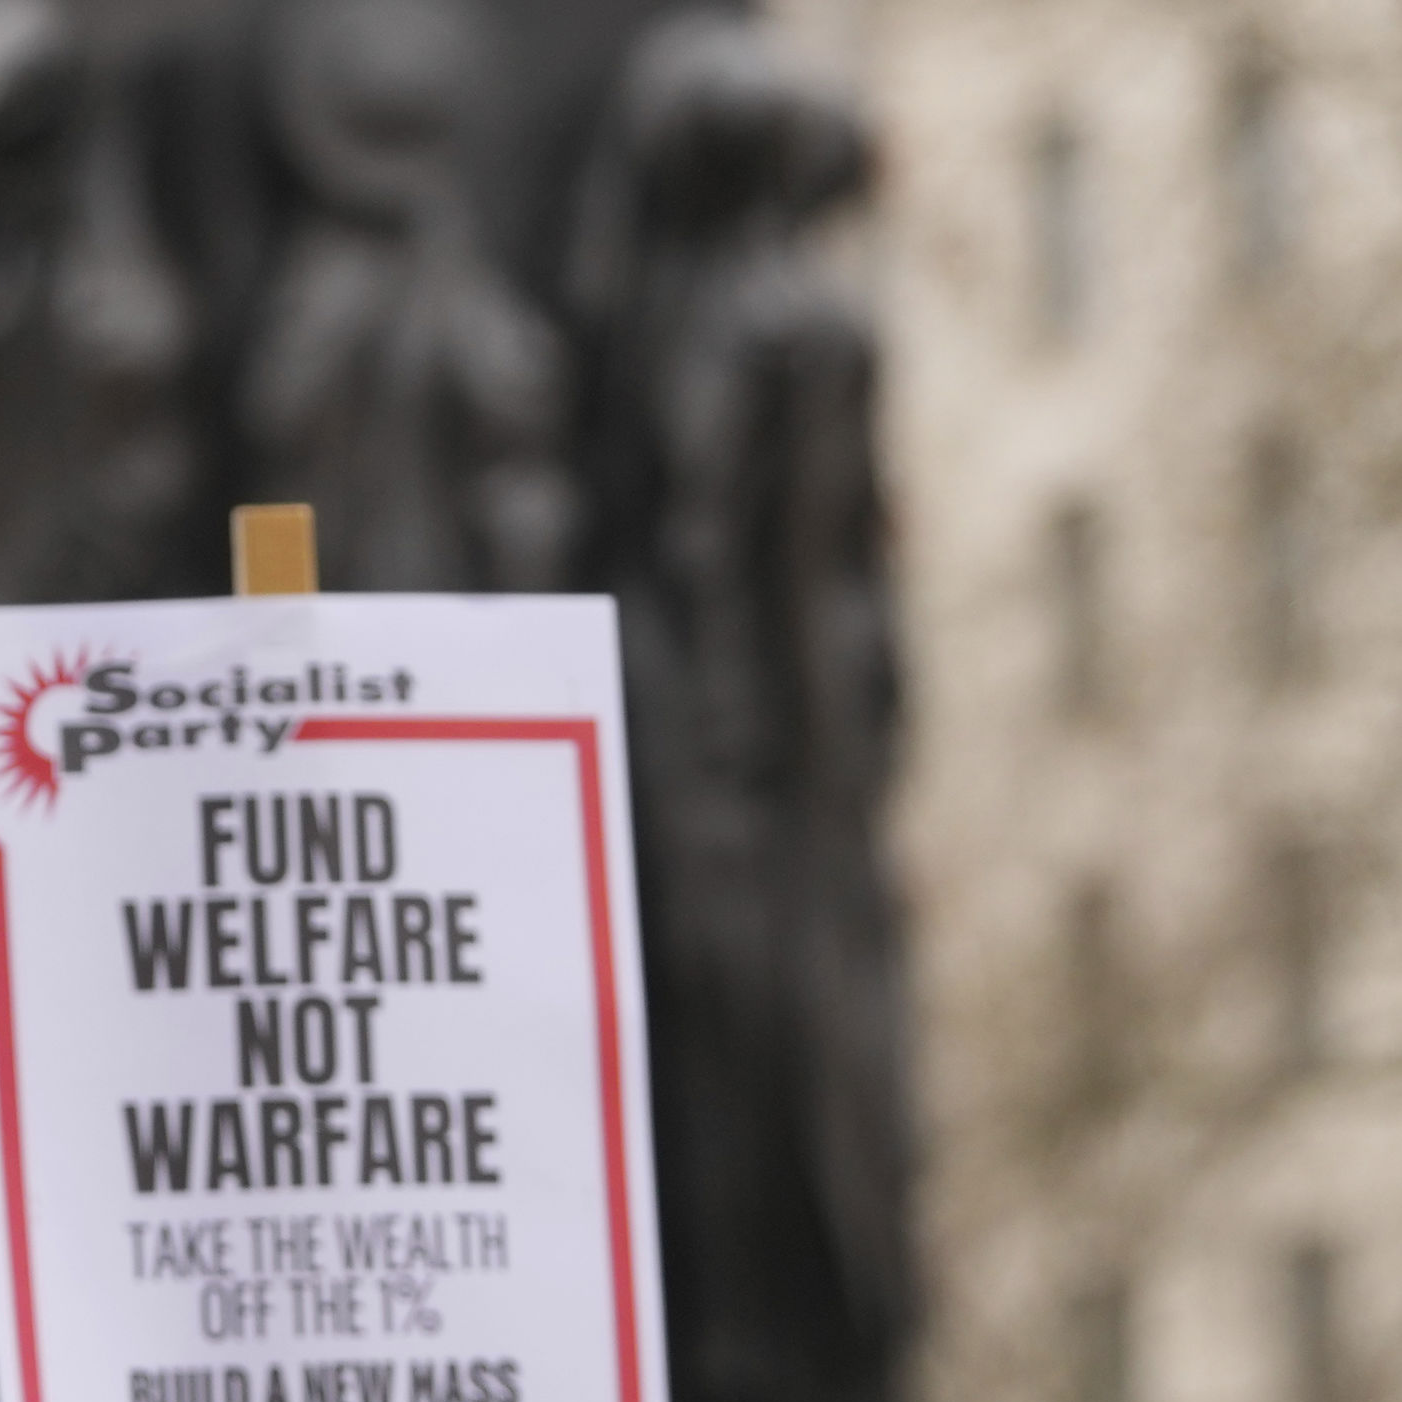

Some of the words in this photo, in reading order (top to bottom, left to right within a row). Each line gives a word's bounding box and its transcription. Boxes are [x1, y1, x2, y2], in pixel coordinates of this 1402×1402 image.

[84, 661, 415, 715] Socialist
[197, 792, 399, 887] FUND
[122, 893, 484, 991] WELFARE
[236, 995, 383, 1087] NOT
[123, 1093, 503, 1193] WARFARE
[127, 1219, 232, 1280] TAKE
[250, 1215, 323, 1276] THE
[334, 1211, 510, 1273] WEALTH
[200, 1279, 274, 1342] OFF
[293, 1278, 363, 1337] THE
[378, 1276, 443, 1336] 1%
